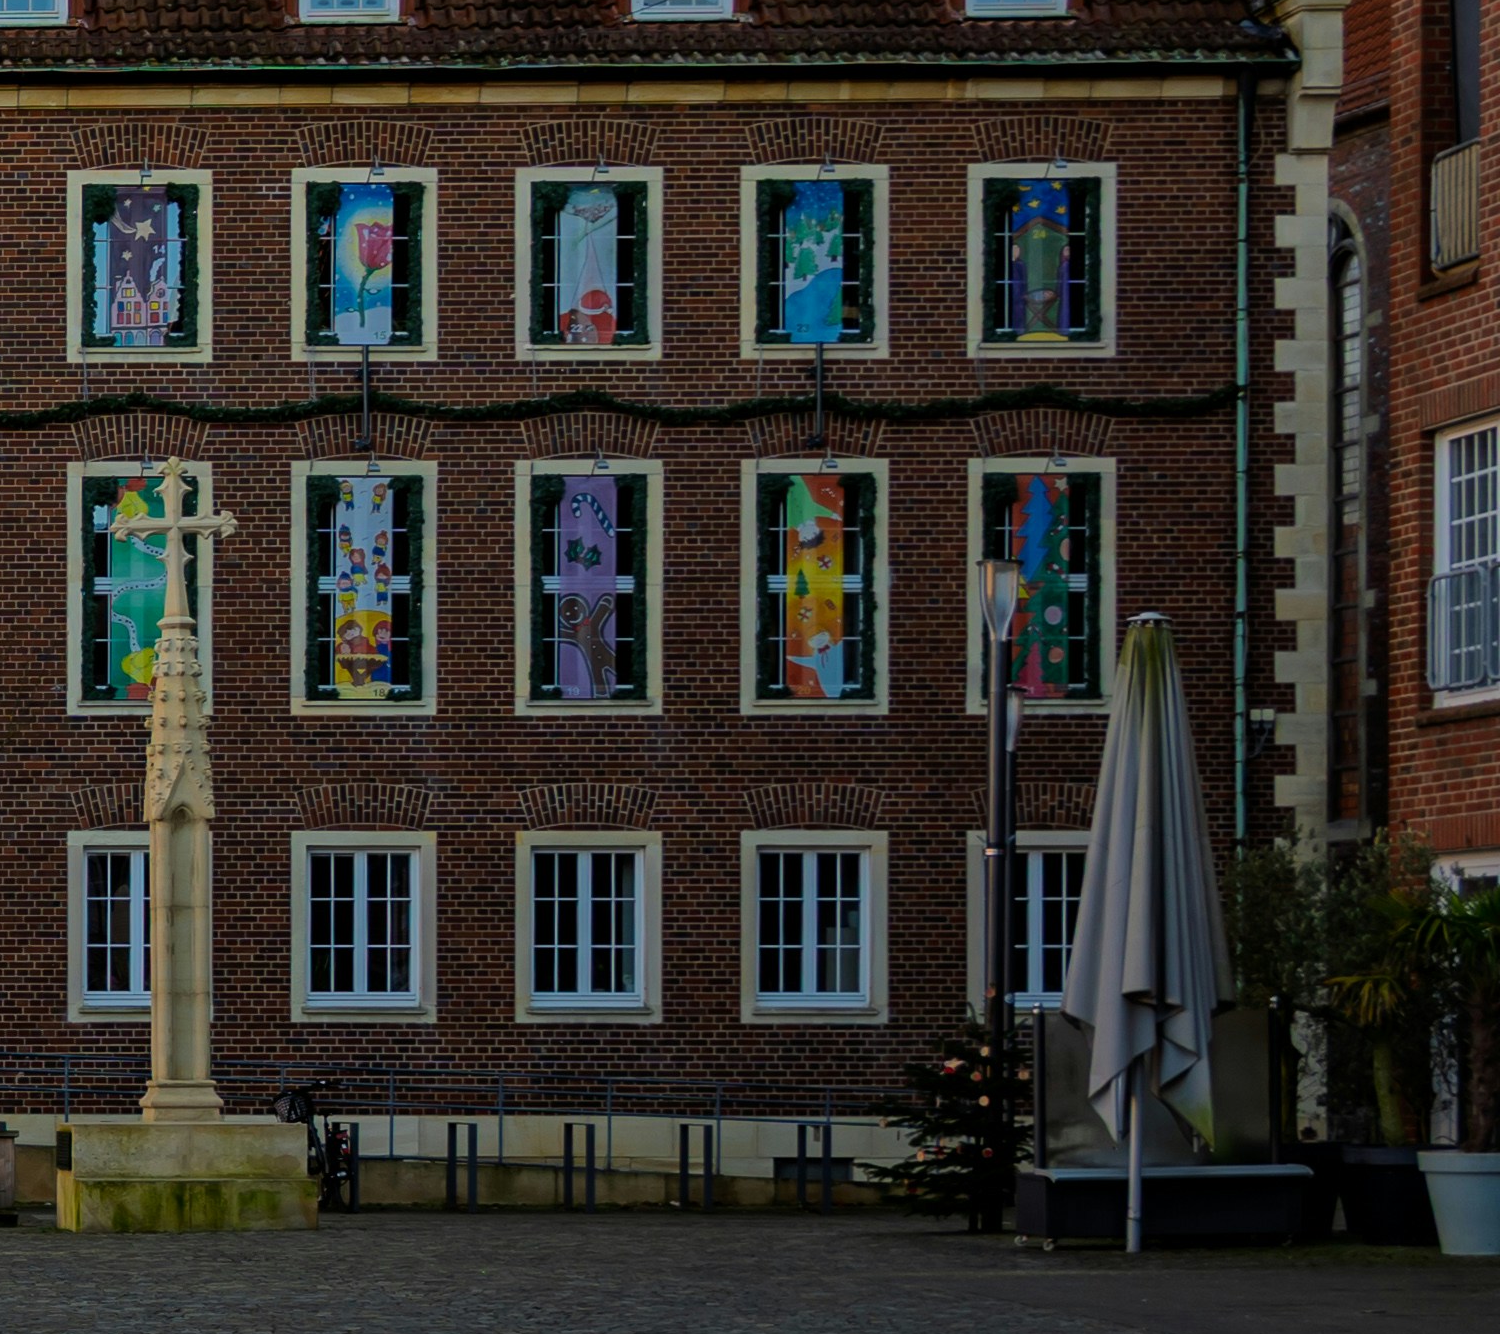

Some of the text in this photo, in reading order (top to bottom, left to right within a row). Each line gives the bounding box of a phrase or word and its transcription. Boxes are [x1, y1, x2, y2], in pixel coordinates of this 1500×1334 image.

[1032, 229, 1048, 239] 24
[152, 244, 166, 254] 14
[570, 323, 584, 333] 22
[796, 323, 811, 333] 23
[373, 330, 386, 340] 15
[373, 688, 386, 697] 18
[566, 686, 581, 696] 19
[795, 686, 811, 695] 20
